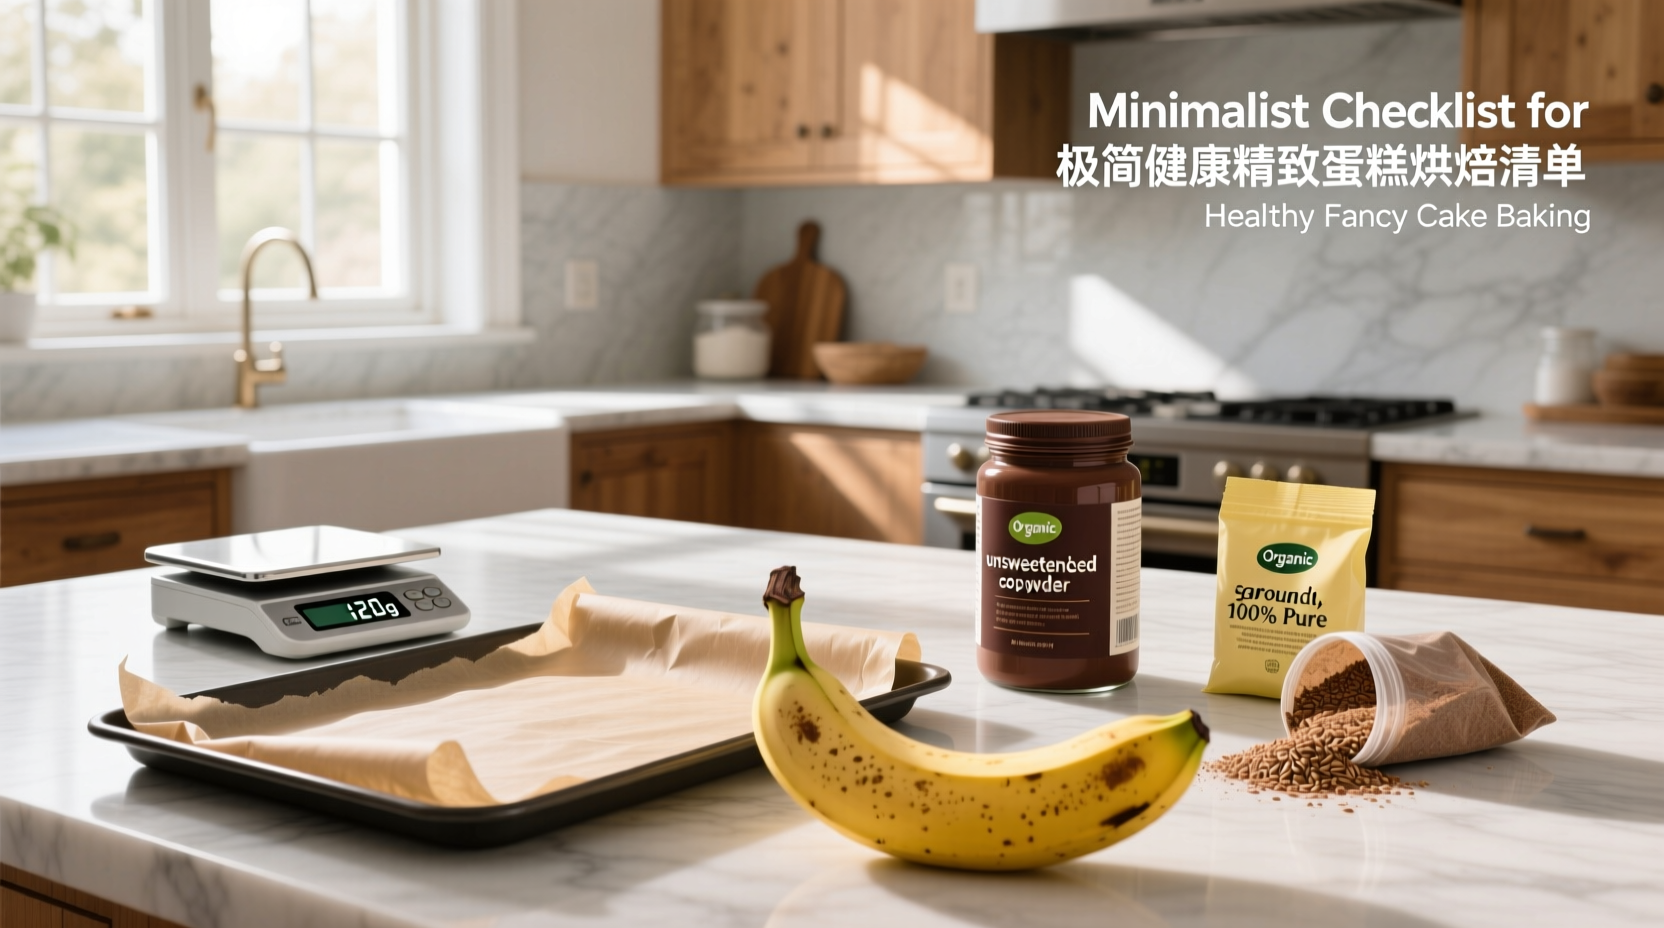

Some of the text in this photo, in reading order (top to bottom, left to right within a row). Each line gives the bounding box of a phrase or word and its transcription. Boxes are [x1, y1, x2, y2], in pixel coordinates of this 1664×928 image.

[1263, 549, 1314, 568] Organic
[347, 598, 400, 620] 120g
[1227, 602, 1328, 628] 100% Pure
